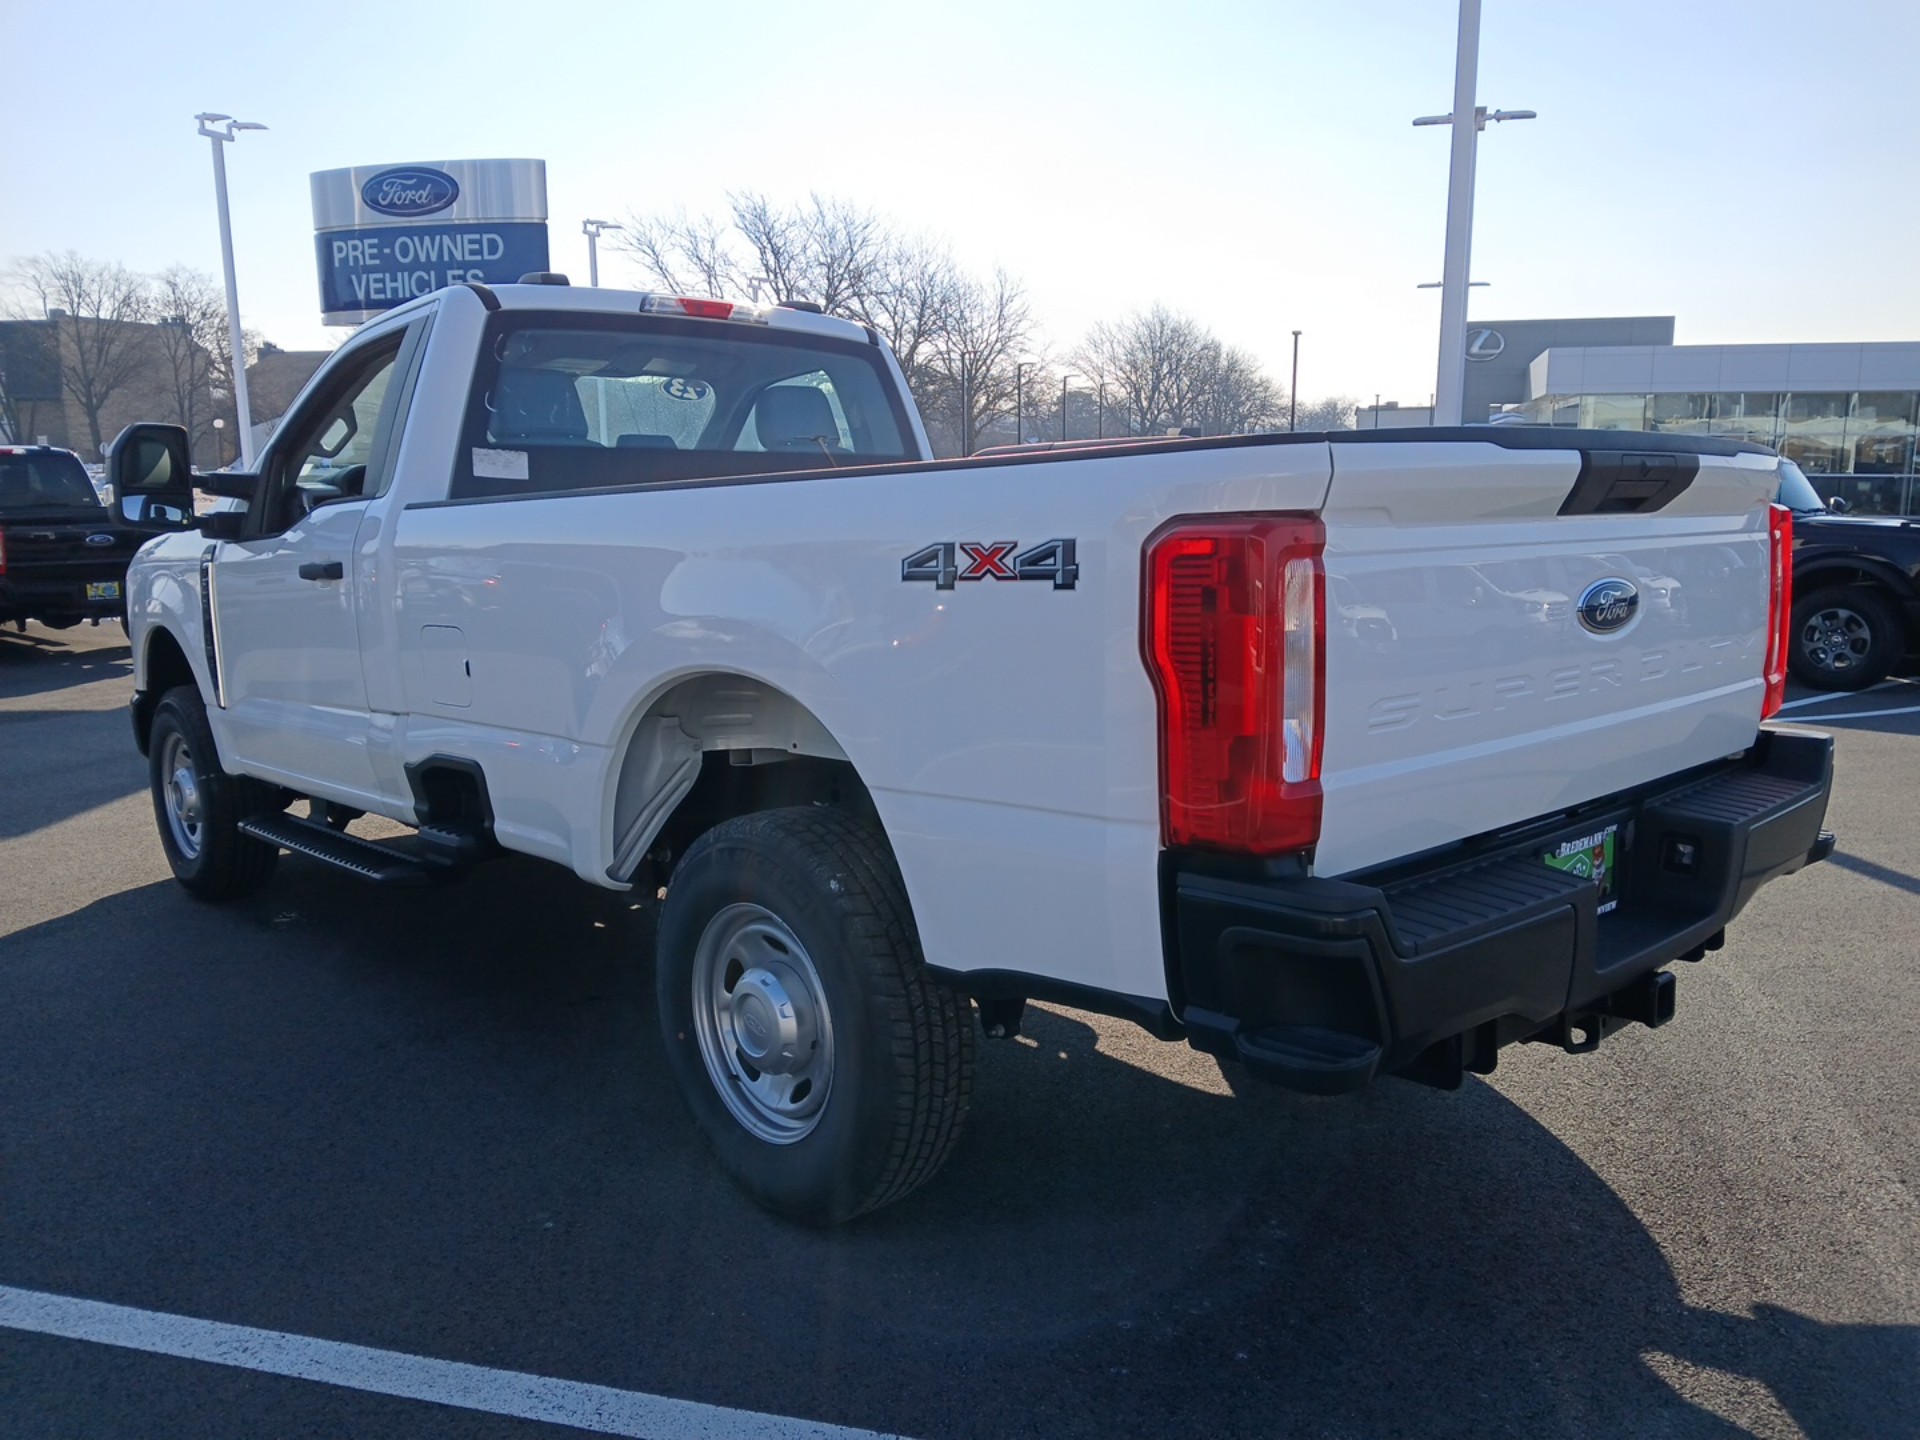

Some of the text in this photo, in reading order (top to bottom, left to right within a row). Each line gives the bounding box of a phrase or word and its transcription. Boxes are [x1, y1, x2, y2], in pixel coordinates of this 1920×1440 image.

[378, 177, 432, 206] Ford
[332, 233, 504, 267] PRE-OWNED
[1596, 590, 1631, 621] Ford
[1368, 657, 1622, 735] SUPER
